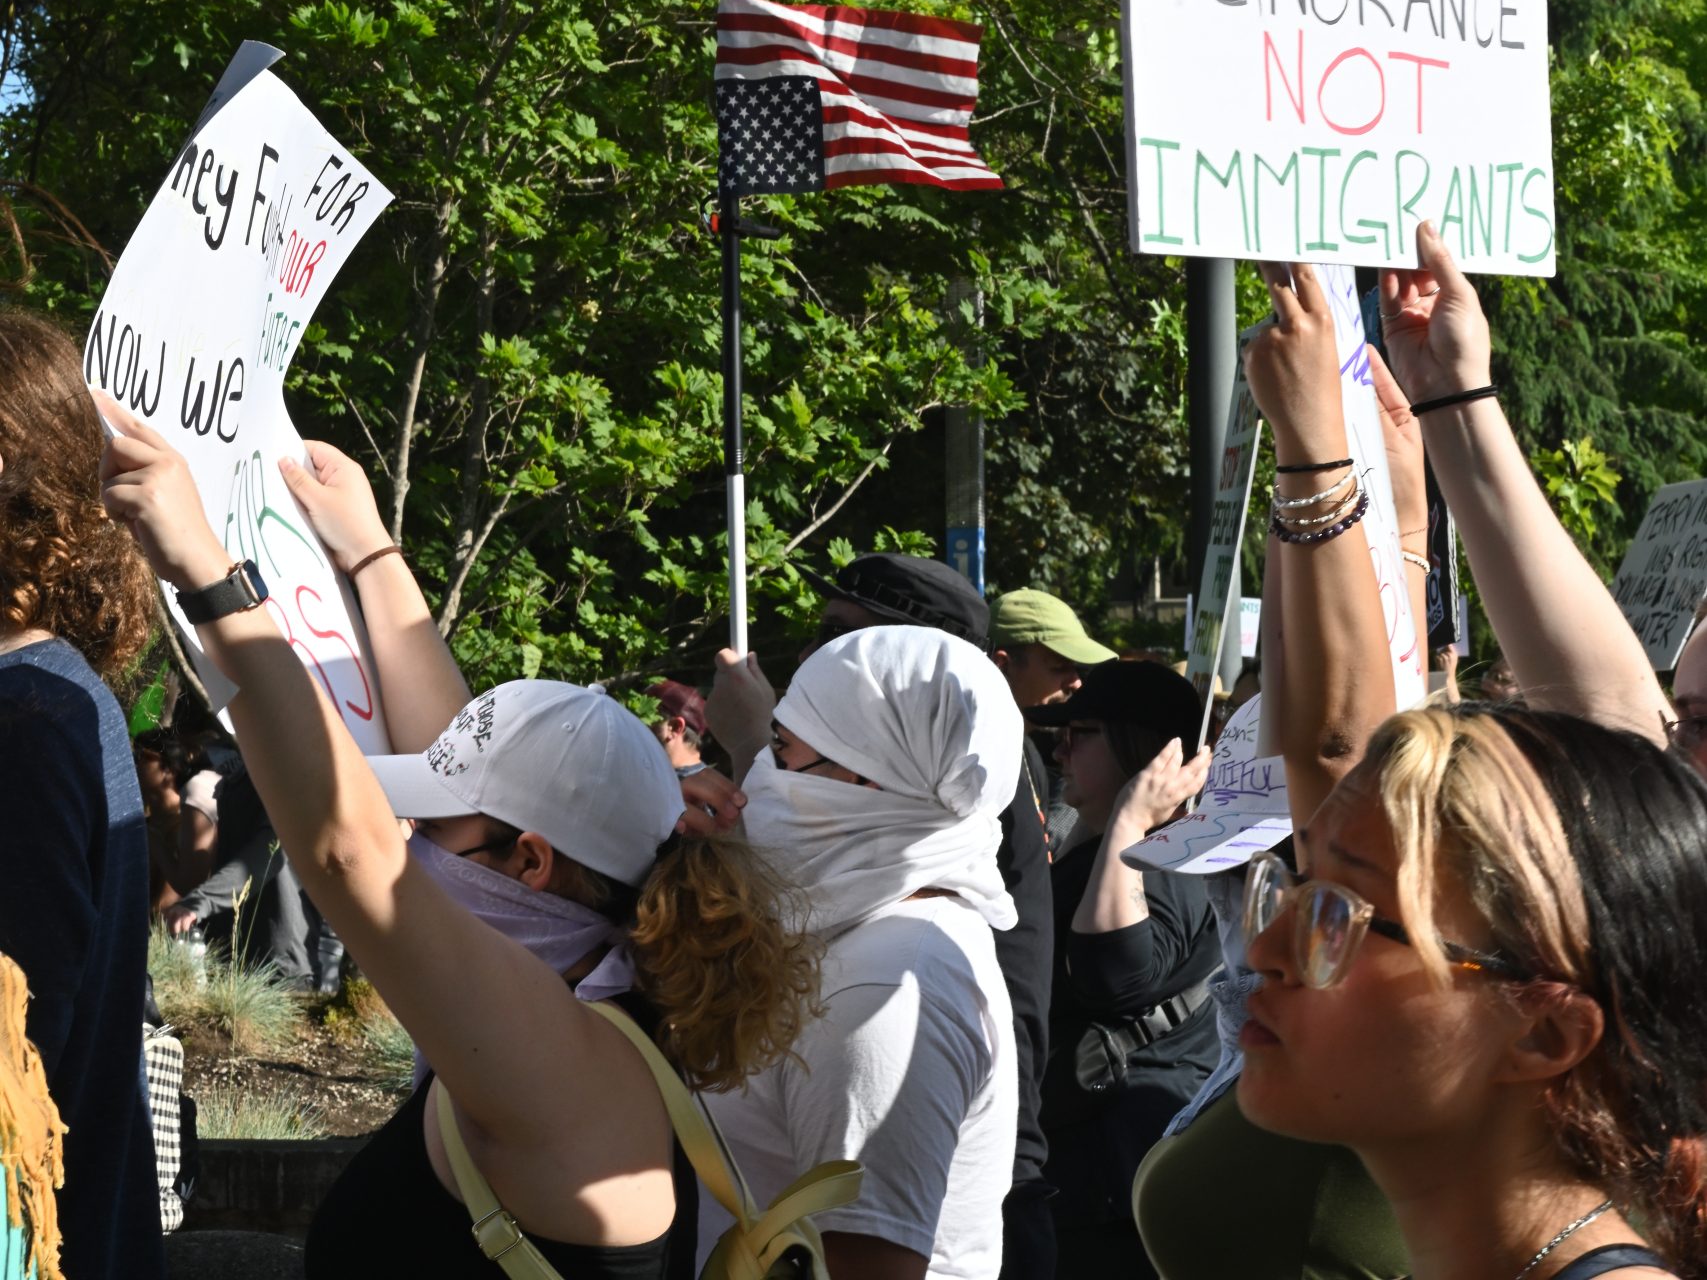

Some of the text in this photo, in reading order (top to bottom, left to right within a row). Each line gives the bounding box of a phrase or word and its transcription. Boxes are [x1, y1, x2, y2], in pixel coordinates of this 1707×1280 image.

[1262, 28, 1450, 136] NOT
[171, 142, 239, 250] hey
[304, 154, 370, 235] FOR
[1139, 137, 1556, 264] IMMIGRANTS
[279, 229, 327, 298] OUR
[86, 309, 166, 418] NOW
[1642, 493, 1698, 541] TERRY
[1203, 756, 1287, 792] AUTIFUL
